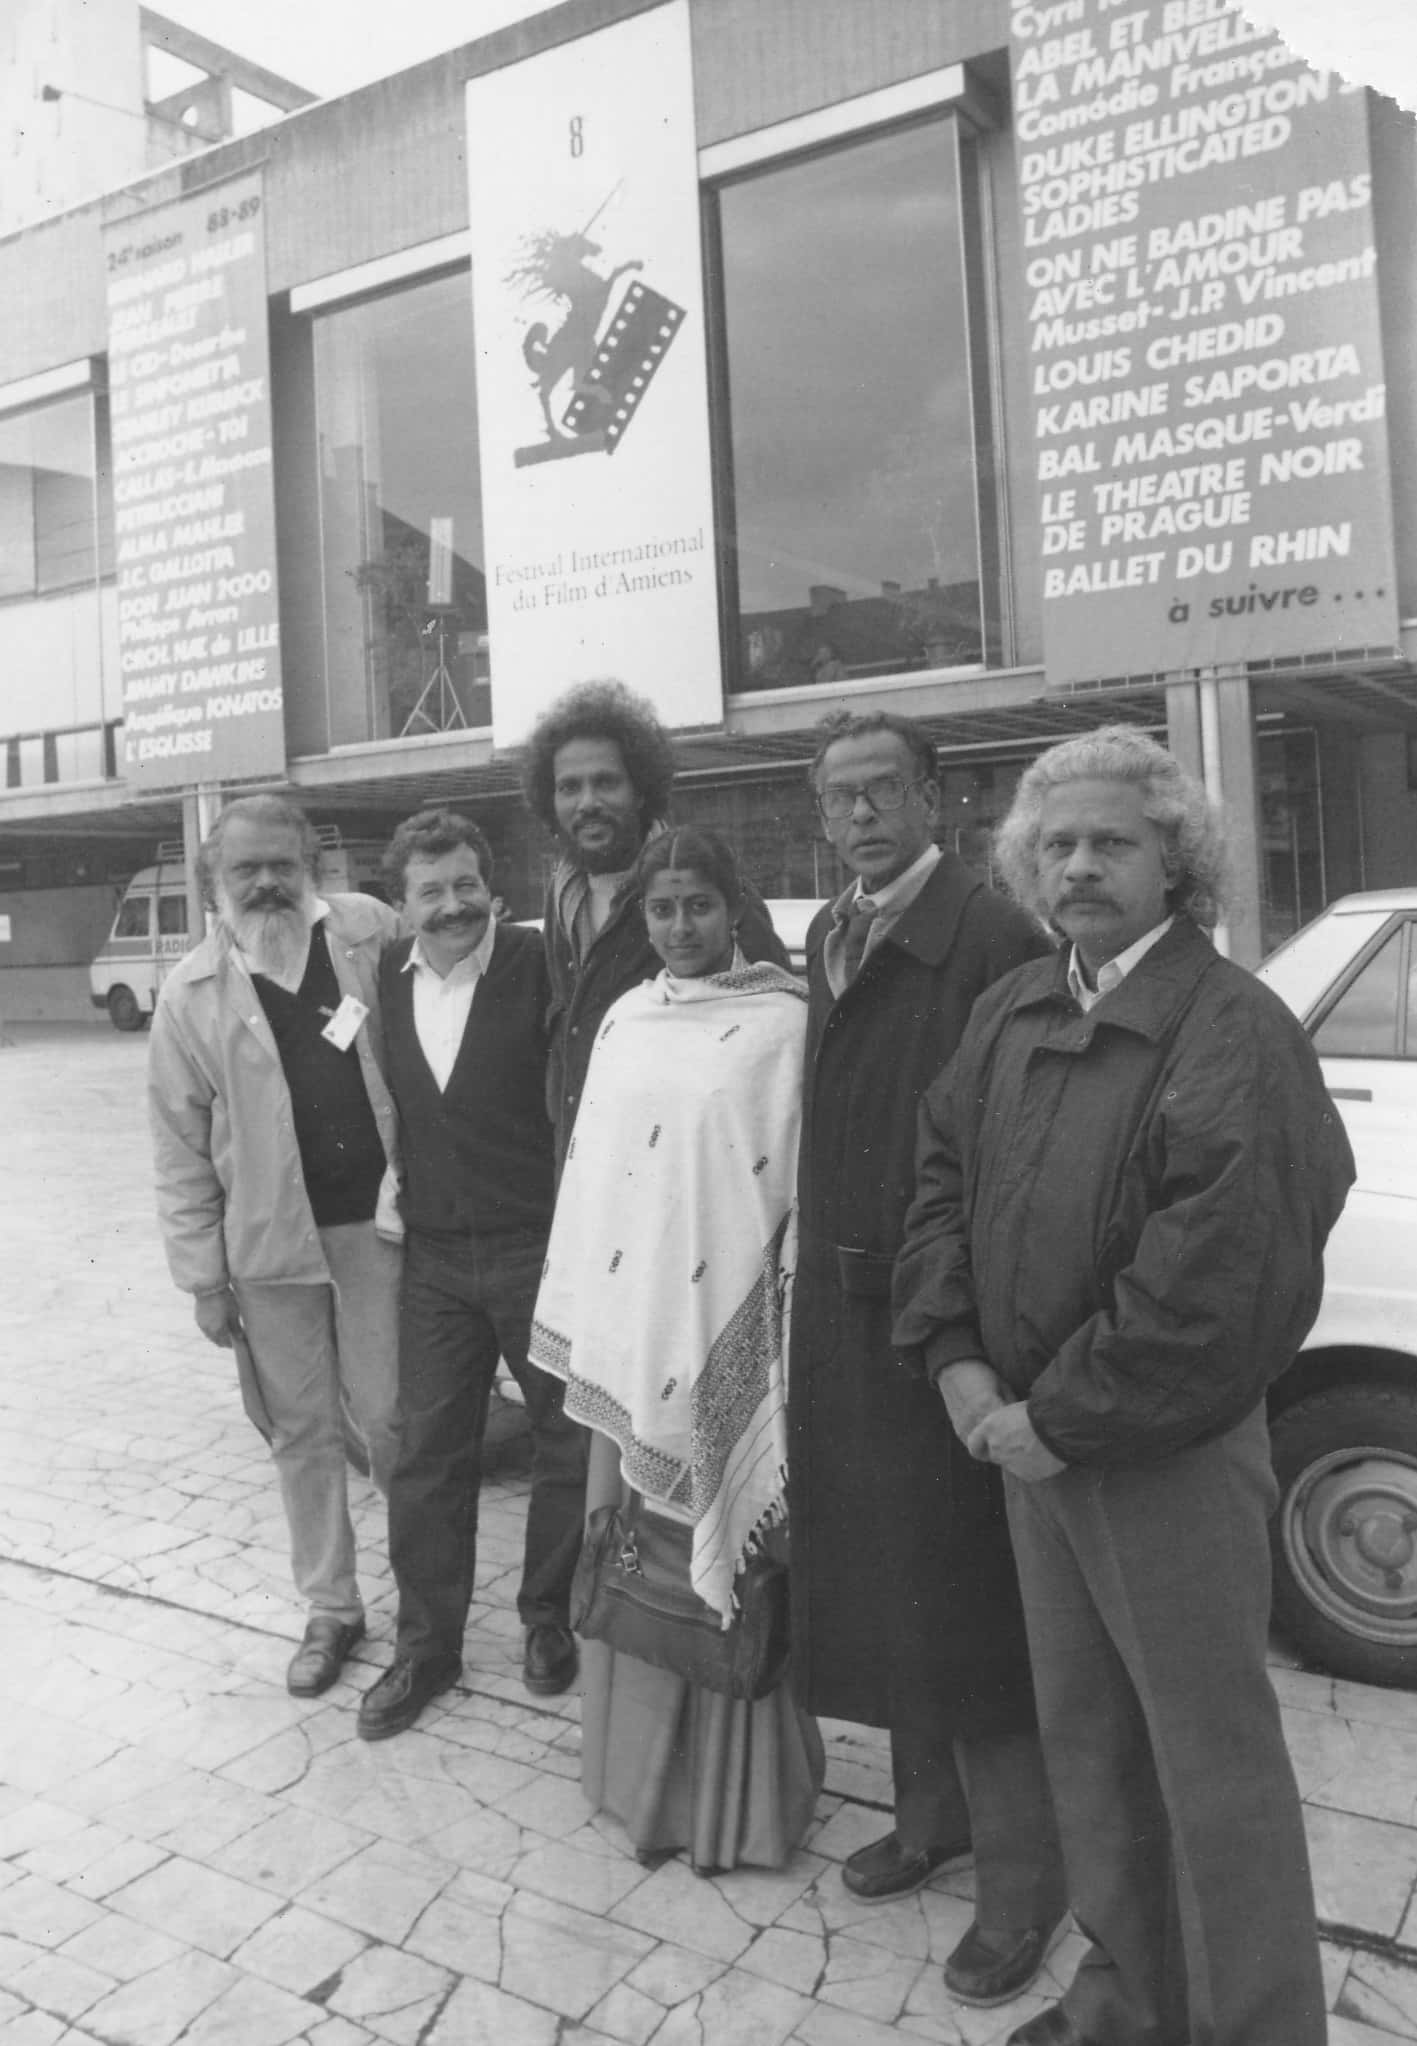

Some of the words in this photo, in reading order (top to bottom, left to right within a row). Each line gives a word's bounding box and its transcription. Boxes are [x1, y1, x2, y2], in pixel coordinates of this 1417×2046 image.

[1015, 28, 1098, 81] ABEL
[1109, 9, 1151, 50] ET
[1162, 0, 1240, 34] BEL
[1016, 73, 1060, 112] LA
[1070, 12, 1272, 96] MANIVELL
[1017, 78, 1158, 141] Comédie
[1169, 44, 1303, 99] França
[569, 115, 584, 159] 8
[1020, 130, 1115, 184] DUKE
[1123, 70, 1362, 156] ELLINGTON
[1023, 115, 1292, 216] SOPHISTICATED
[1025, 191, 1140, 248] LADIES
[1026, 248, 1083, 289] ON
[1091, 235, 1138, 274] NE
[1148, 195, 1285, 261] BADINE
[1297, 172, 1371, 223] PAS
[1029, 272, 1117, 321] AVEC
[1235, 246, 1377, 305] Vincent
[1034, 347, 1132, 395] LOUIS
[1146, 313, 1285, 370] CHEDID
[1036, 382, 1169, 438] KARINE
[1184, 343, 1361, 407] SAPORTA
[1038, 442, 1100, 481] BAL
[1041, 489, 1076, 524] LE
[1093, 459, 1246, 515] THEATRE
[1259, 437, 1364, 486] NOIR
[1042, 521, 1087, 556] DE
[1101, 491, 1252, 546] PRAGUE
[495, 553, 563, 587] Festival
[572, 528, 704, 573] International
[1044, 551, 1166, 600] BALLET
[1176, 541, 1233, 580] DU
[1249, 522, 1352, 569] RHIN
[120, 593, 158, 621] DON
[165, 581, 212, 612] JUAN
[217, 569, 272, 601] 2000
[513, 589, 536, 612] du
[544, 580, 588, 606] Film
[1168, 597, 1190, 624] à
[237, 623, 279, 652] LILLE
